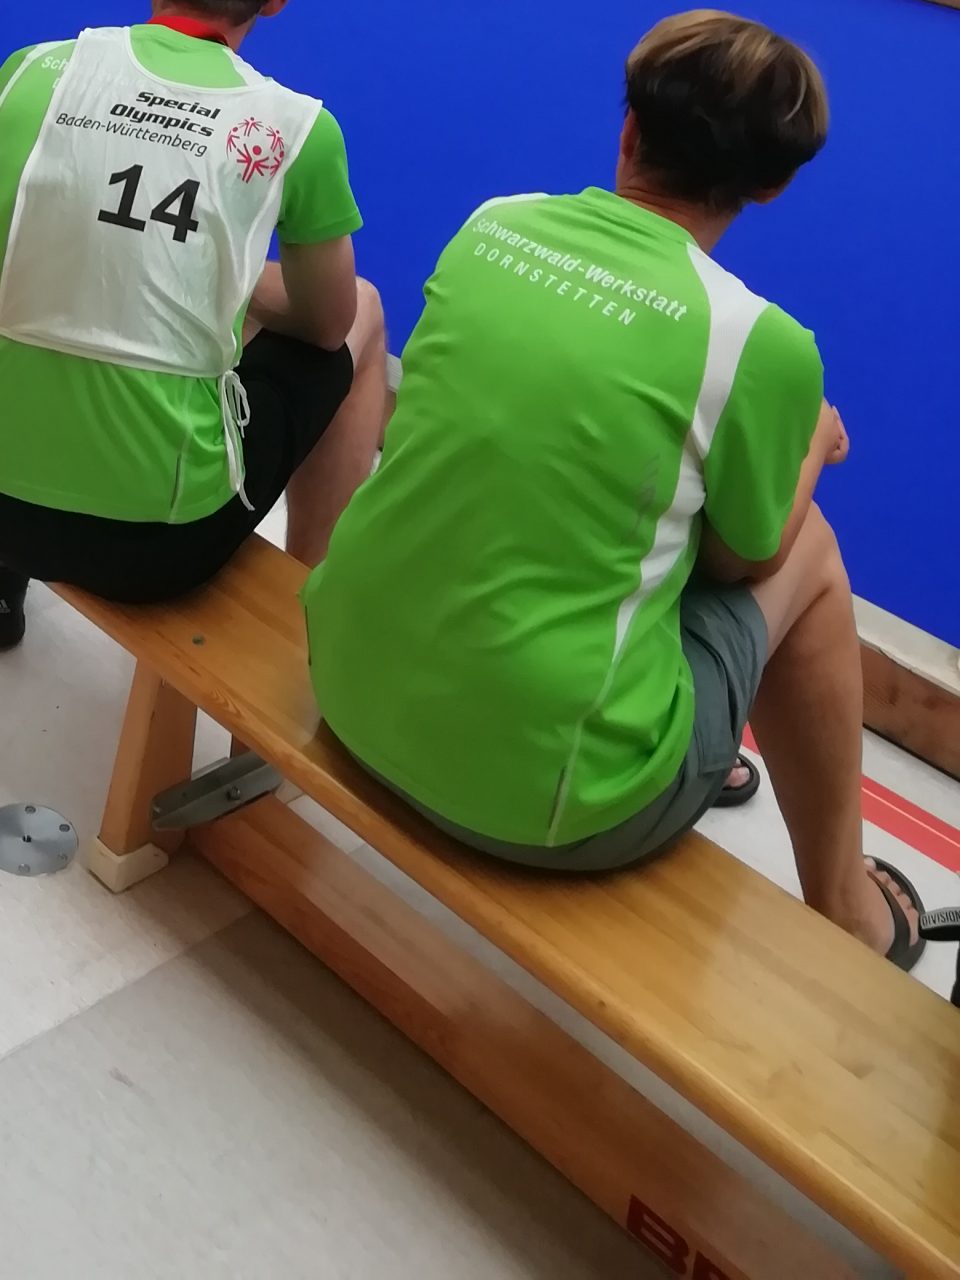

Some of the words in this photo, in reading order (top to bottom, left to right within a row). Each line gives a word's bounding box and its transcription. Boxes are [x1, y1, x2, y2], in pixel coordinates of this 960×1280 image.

[55, 112, 208, 157] Baden-Württemberg
[110, 103, 215, 137] Olympics
[136, 91, 222, 120] Special
[97, 163, 200, 243] 14
[472, 218, 688, 321] Schwarzwald-Werkstatt
[474, 242, 637, 326] DORNSTETTEN
